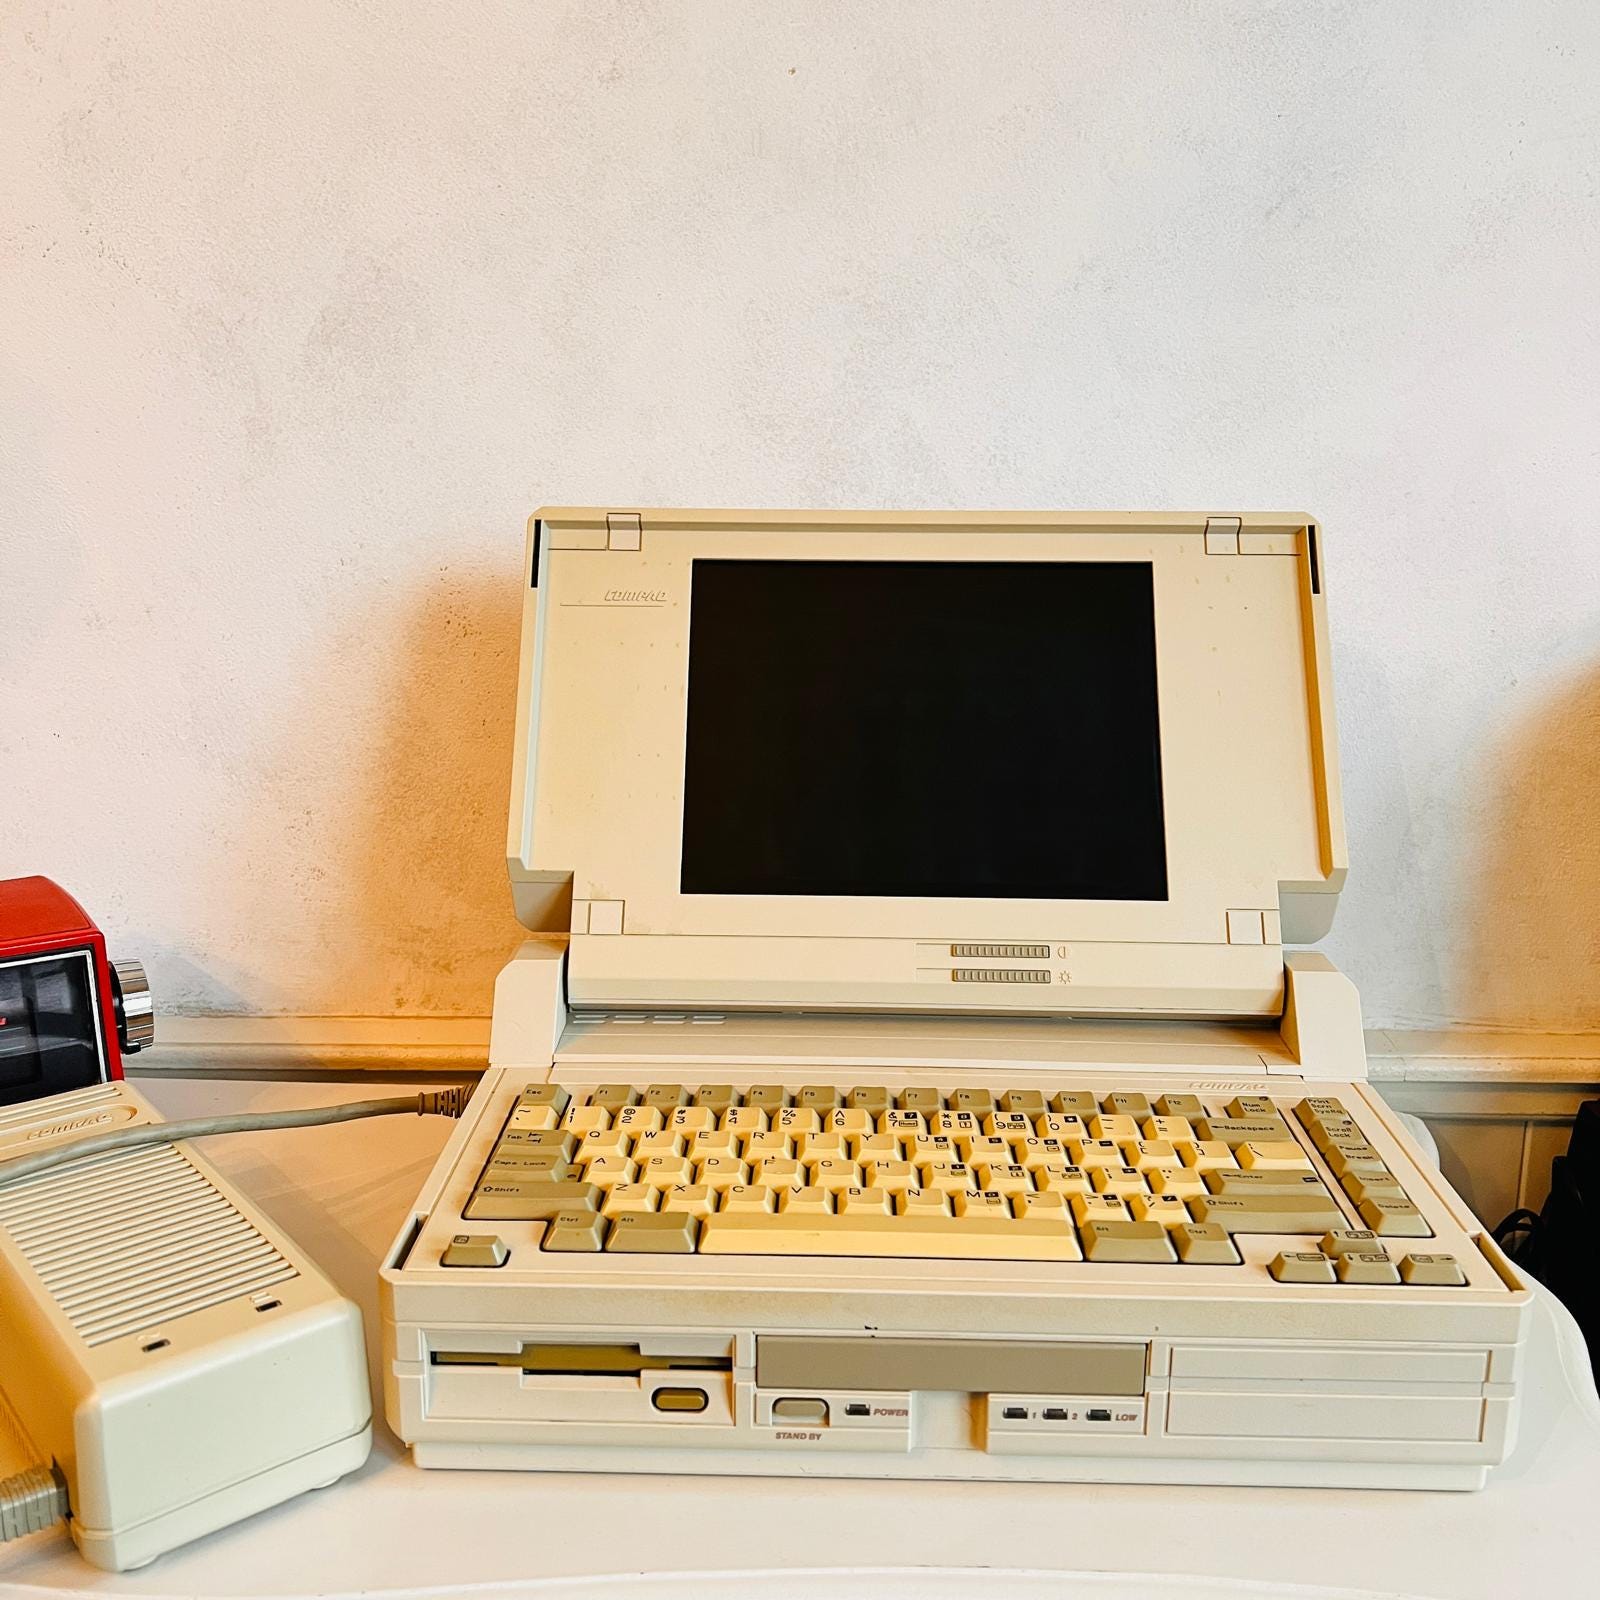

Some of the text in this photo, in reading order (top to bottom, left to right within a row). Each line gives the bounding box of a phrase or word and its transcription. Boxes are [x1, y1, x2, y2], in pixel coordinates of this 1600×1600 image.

[604, 590, 668, 602] COMPAQ
[621, 1115, 632, 1124] 2
[675, 1115, 686, 1124] 3
[781, 1117, 792, 1125] 5
[834, 1118, 845, 1126] 6
[891, 1119, 899, 1127] 7
[942, 1120, 952, 1128] 8
[995, 1121, 1006, 1129] 9
[808, 1132, 819, 1140] T
[862, 1133, 873, 1141] Y
[1047, 1165, 1060, 1173] L
[615, 1183, 628, 1191] Z
[674, 1184, 686, 1192] X
[732, 1185, 744, 1193] C
[791, 1186, 802, 1194] V
[849, 1187, 861, 1195] B
[908, 1189, 920, 1197] N
[966, 1190, 980, 1198] M
[873, 1408, 909, 1417] POWER
[1071, 1412, 1078, 1420] 2
[1115, 1413, 1138, 1421] LOW
[775, 1432, 822, 1440] STAND BY
